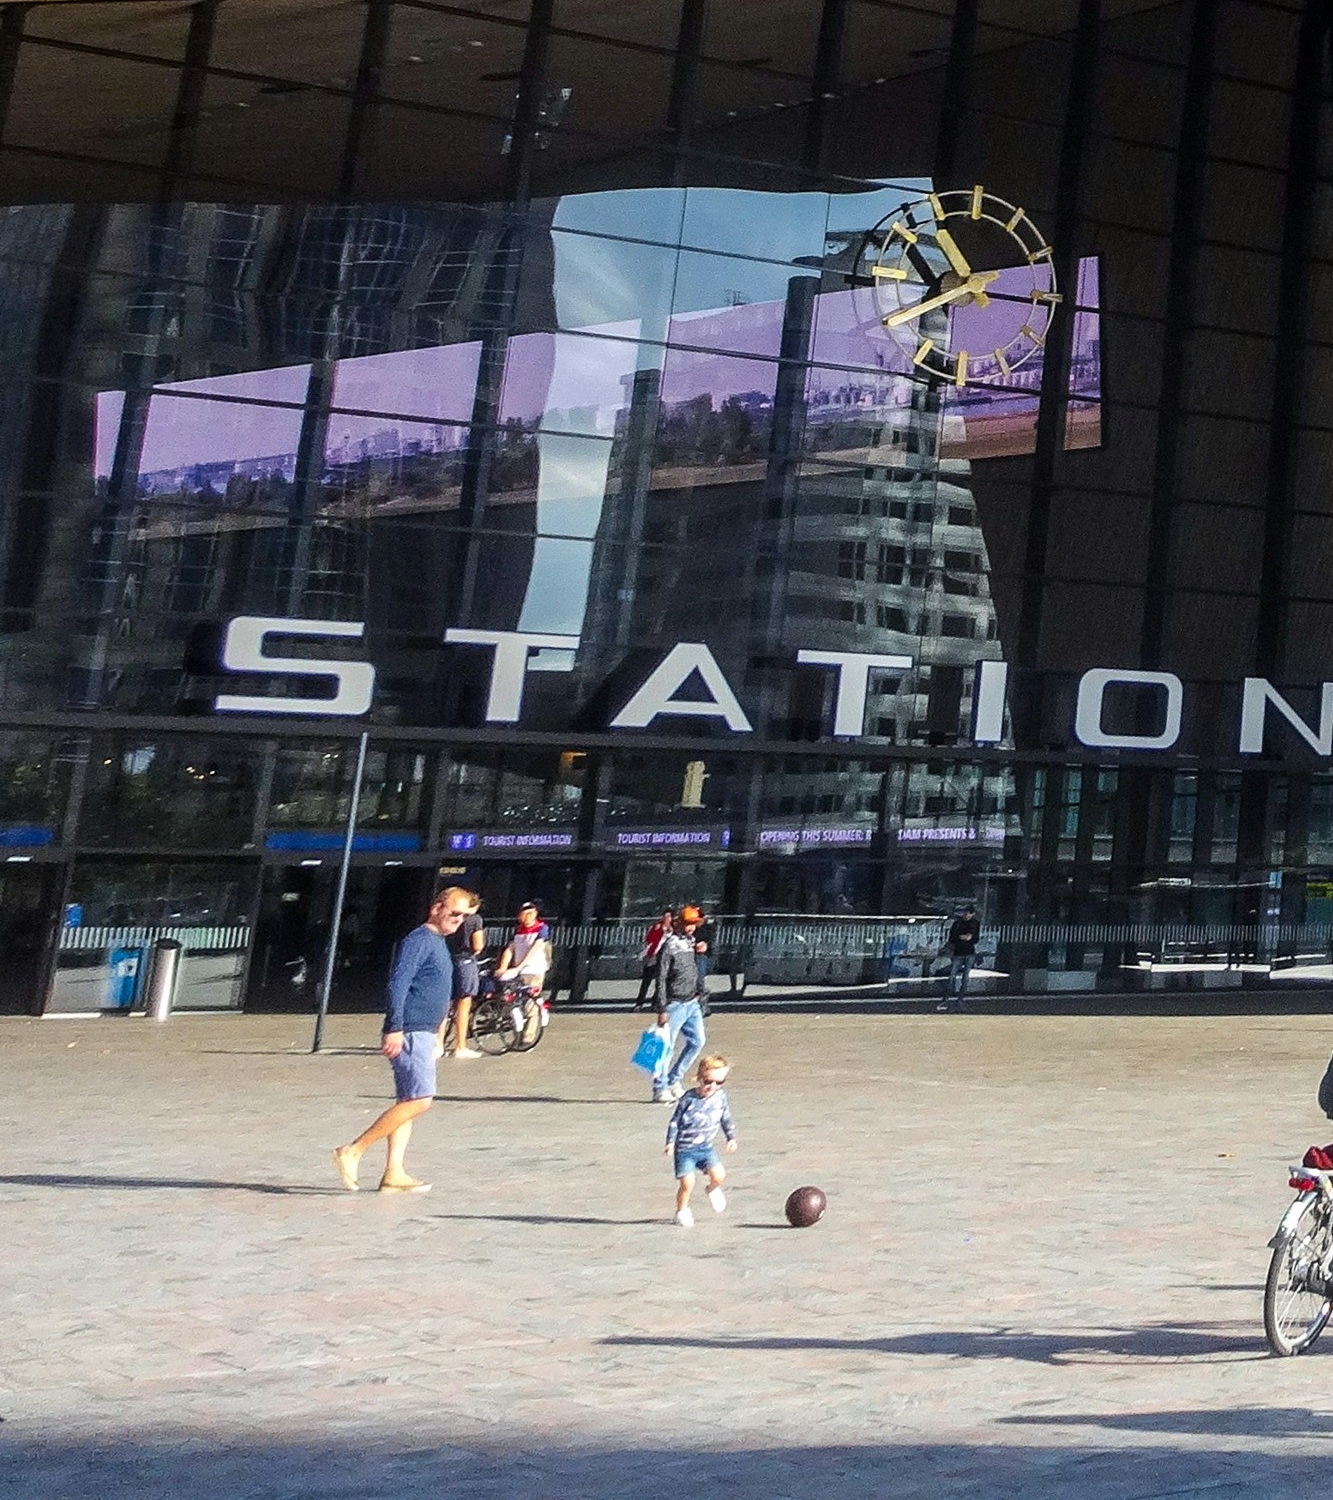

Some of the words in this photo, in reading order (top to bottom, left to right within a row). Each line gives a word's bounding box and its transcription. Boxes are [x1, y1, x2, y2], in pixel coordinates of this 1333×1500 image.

[482, 835, 515, 846] TOURIST
[516, 834, 572, 846] INFORMATION
[618, 833, 651, 844] TOURIST
[652, 832, 710, 844] INFORMATION
[760, 831, 799, 842] OPENING
[802, 831, 821, 842] THIS
[922, 828, 967, 840] PRESENTS
